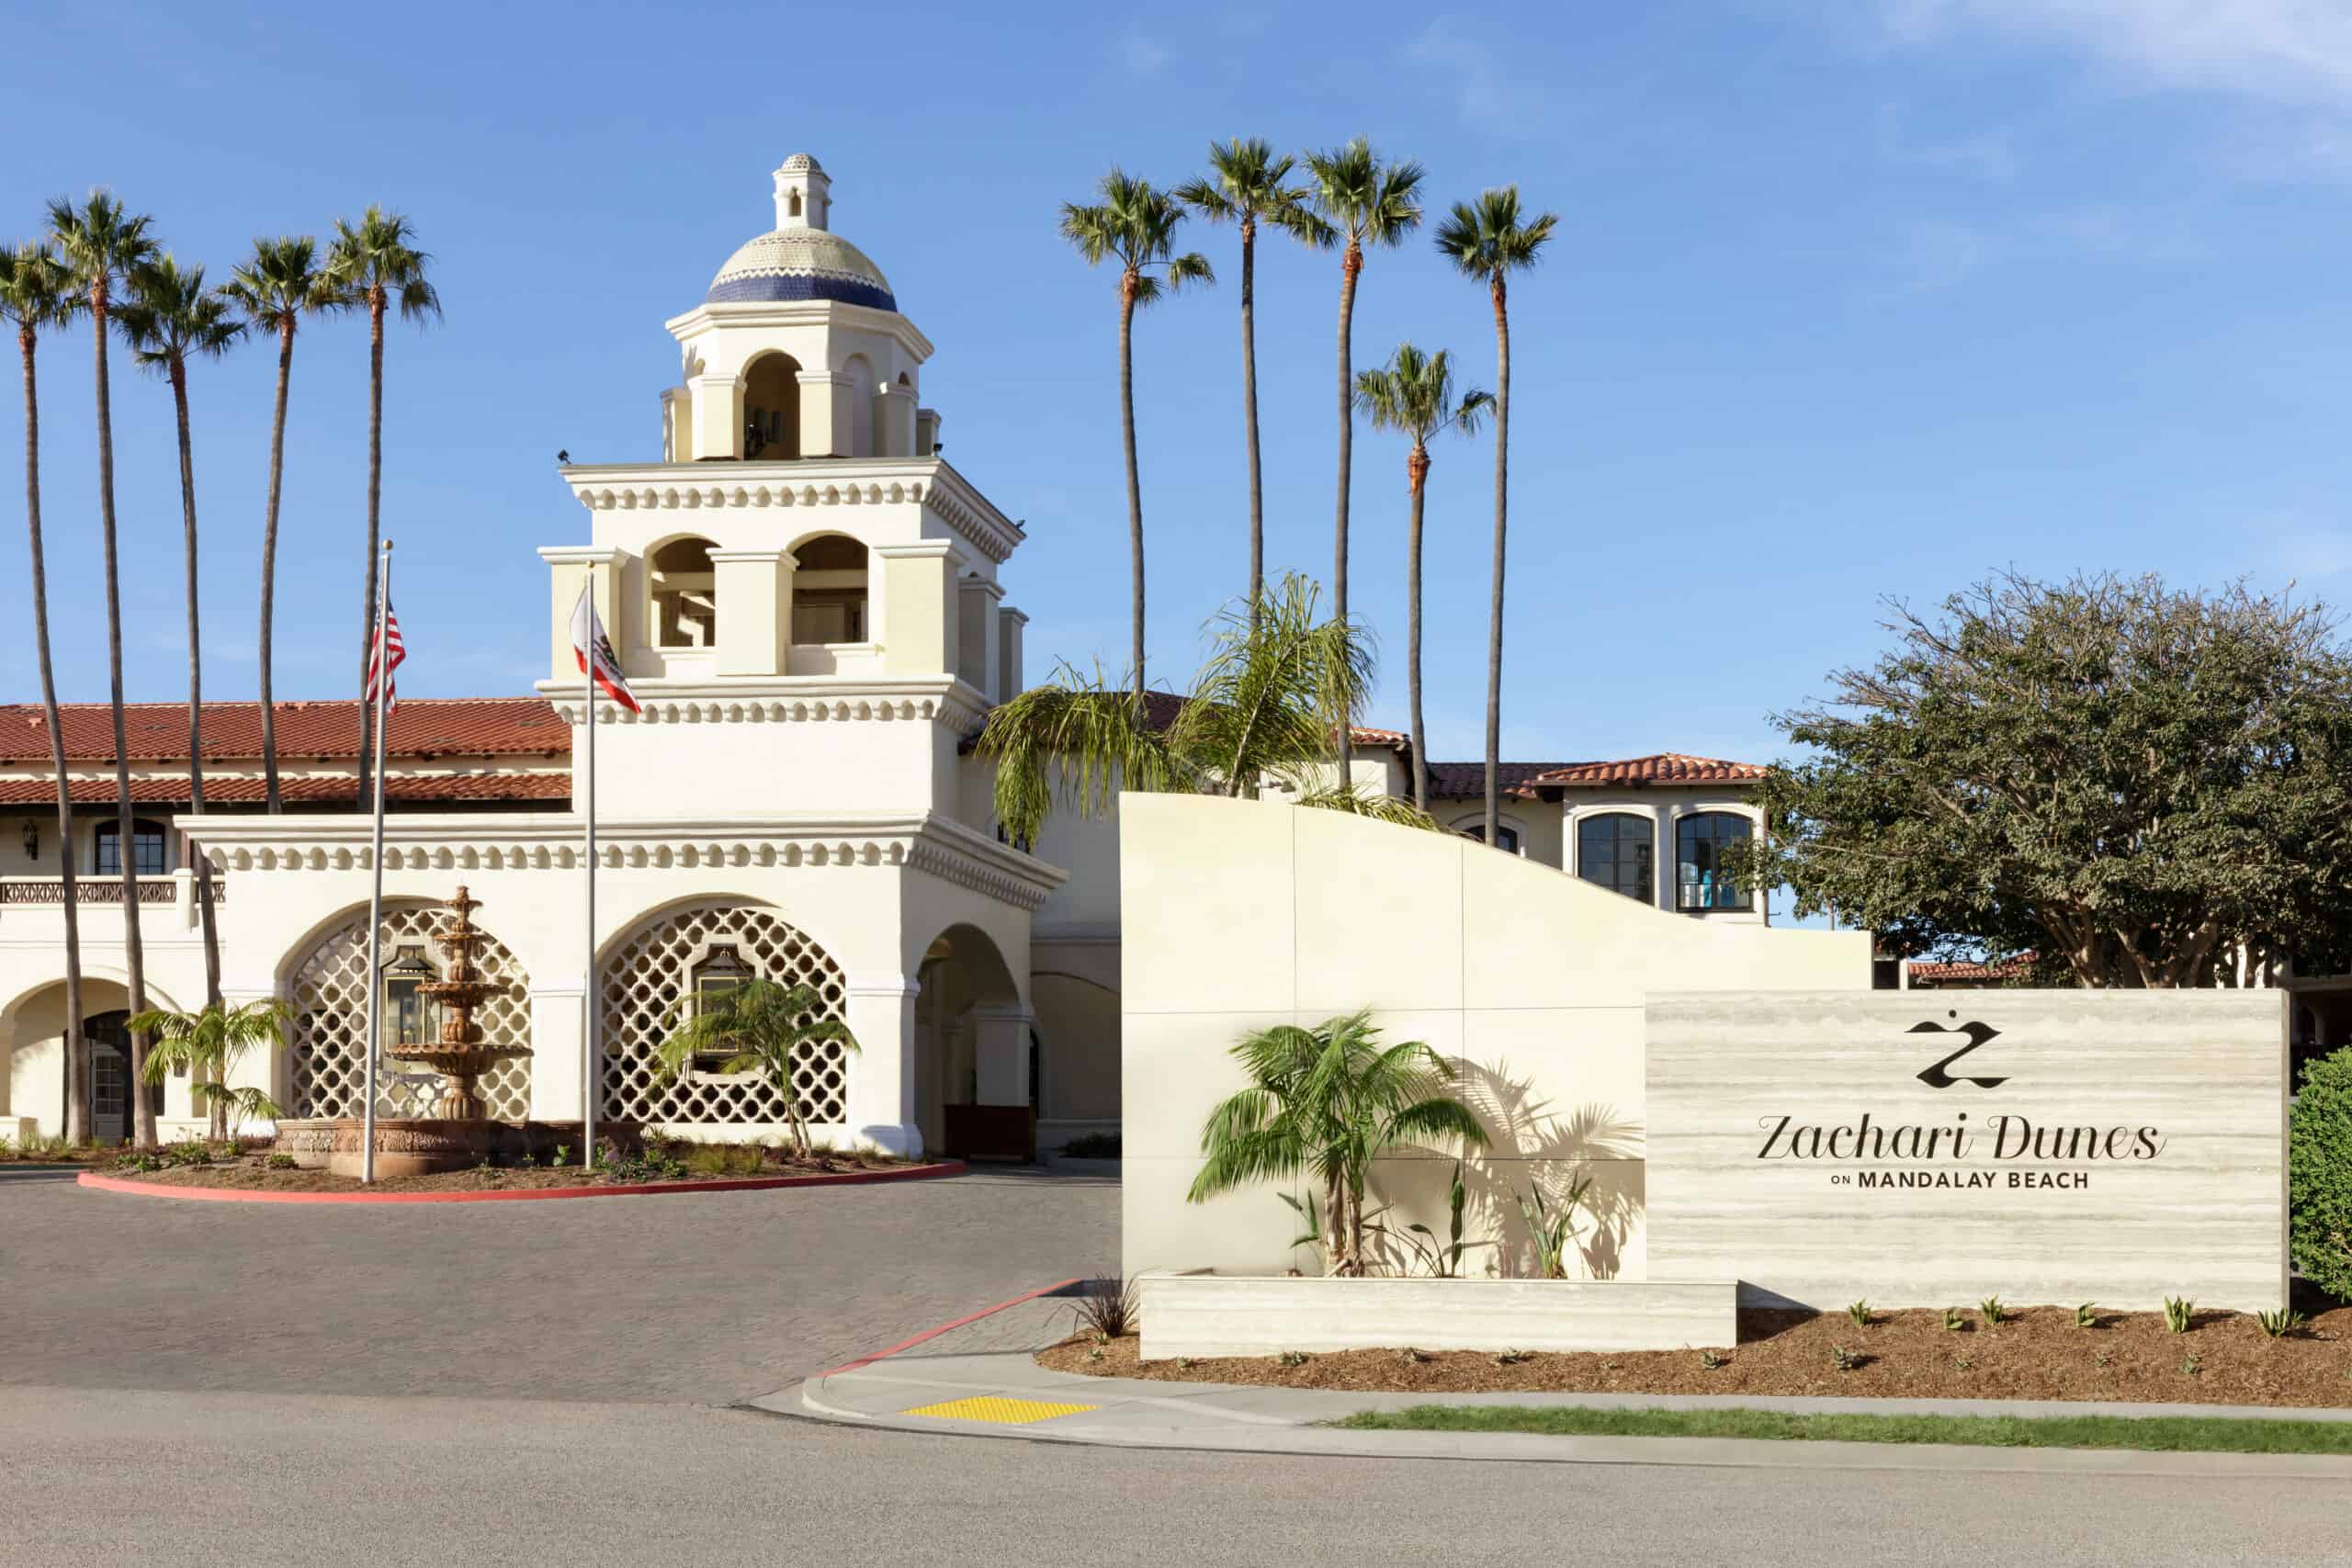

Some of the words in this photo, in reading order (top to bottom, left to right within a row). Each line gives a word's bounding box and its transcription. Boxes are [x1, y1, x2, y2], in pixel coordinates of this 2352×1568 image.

[1757, 1112, 1974, 1160] Zachari
[1986, 1114, 2166, 1160] Dunes
[1830, 1175, 1851, 1185] ON
[1859, 1171, 1996, 1189] MANDALAY
[2007, 1171, 2088, 1190] BEACH
